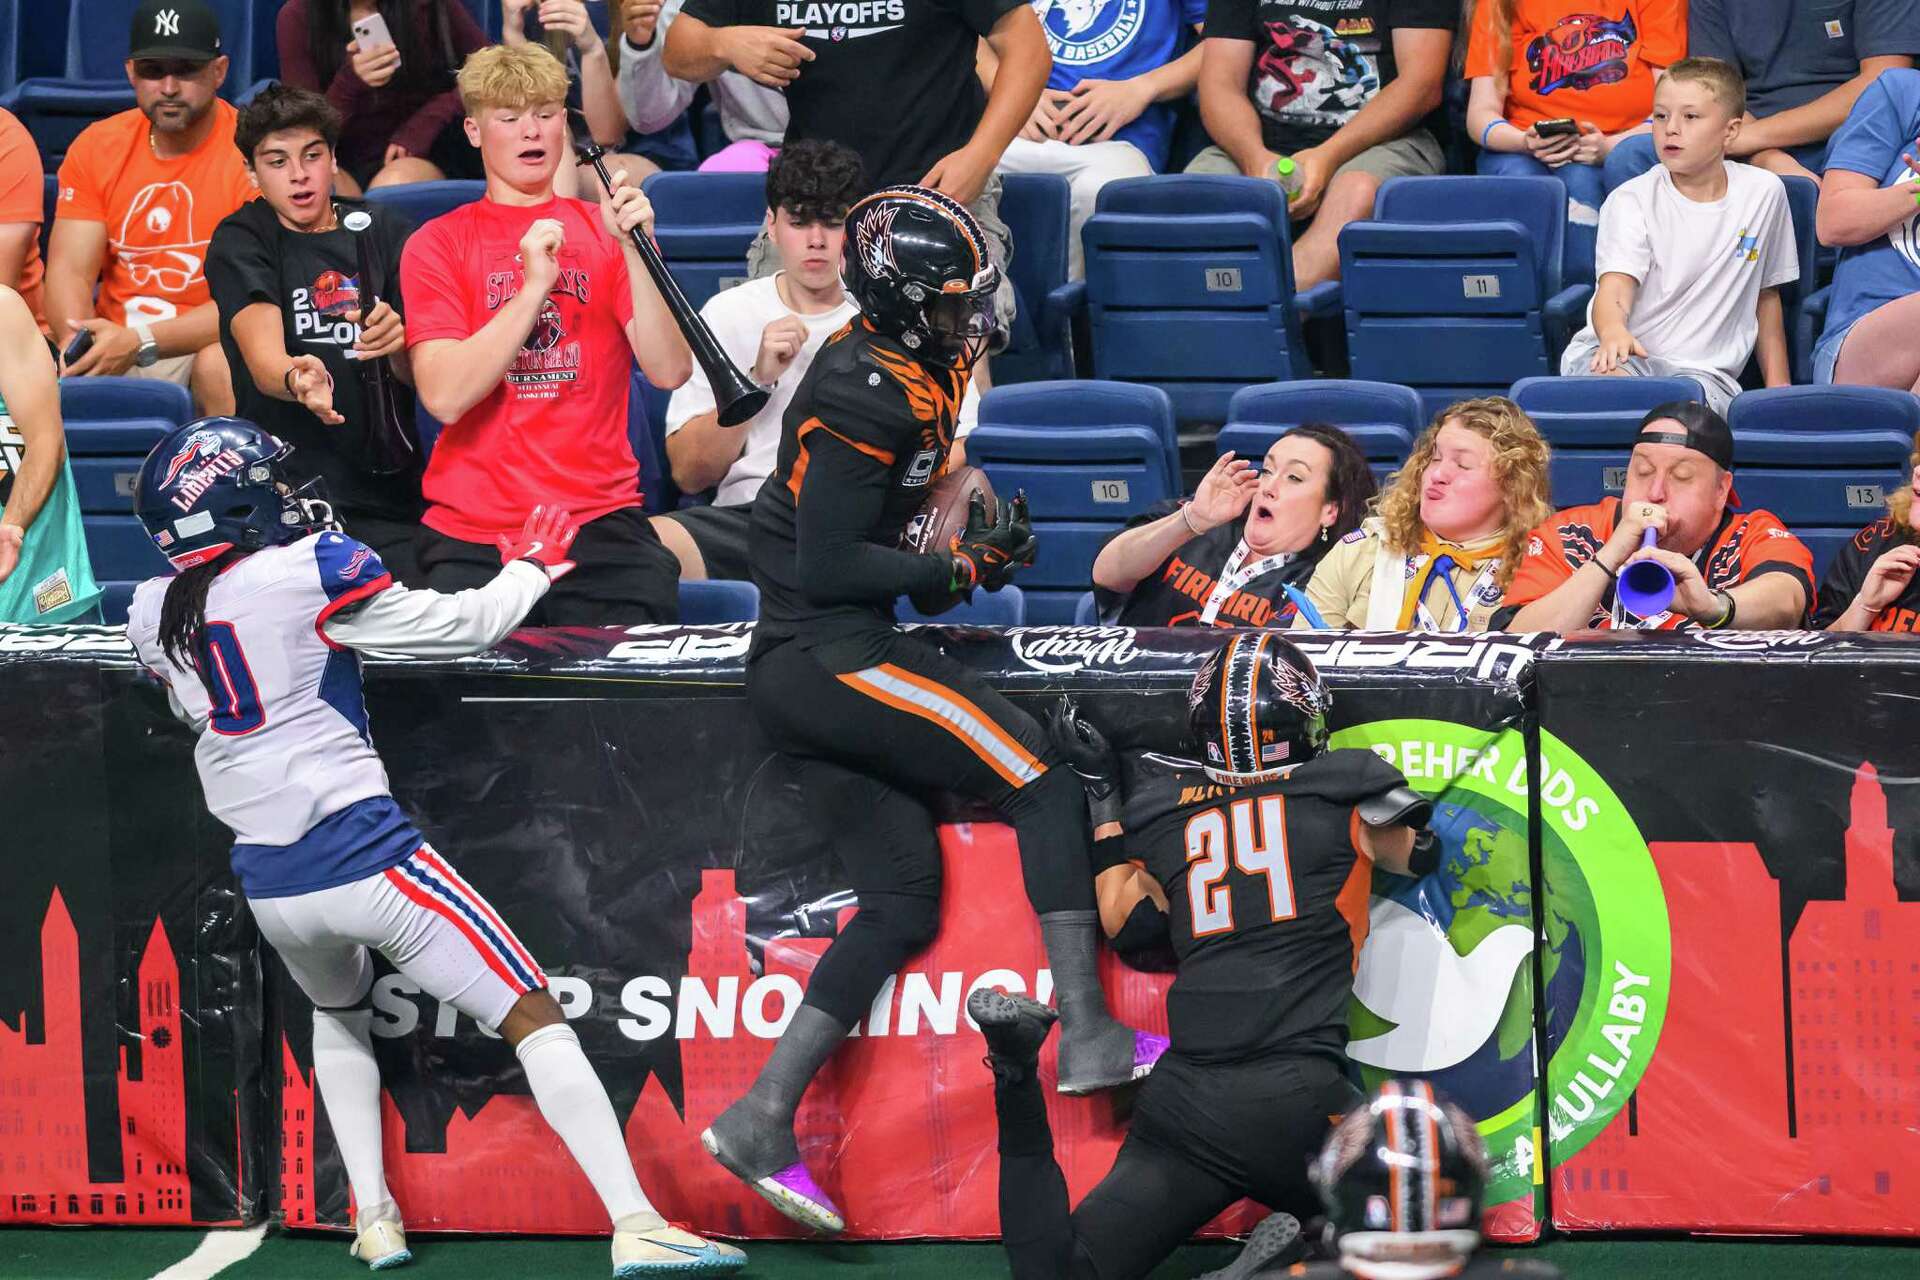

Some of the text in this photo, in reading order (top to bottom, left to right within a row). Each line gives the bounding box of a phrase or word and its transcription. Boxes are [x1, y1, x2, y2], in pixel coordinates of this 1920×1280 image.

[776, 1, 905, 25] PLAYOFFS
[1063, 12, 1137, 60] BASEBALL
[1216, 272, 1232, 287] 10
[1476, 279, 1487, 294] 11
[1102, 484, 1119, 499] 10
[1856, 489, 1874, 504] 13
[187, 620, 267, 737] 0
[1214, 771, 1281, 786] FIREBIRDS
[1505, 752, 1599, 831] DDS
[1184, 794, 1297, 940] 24
